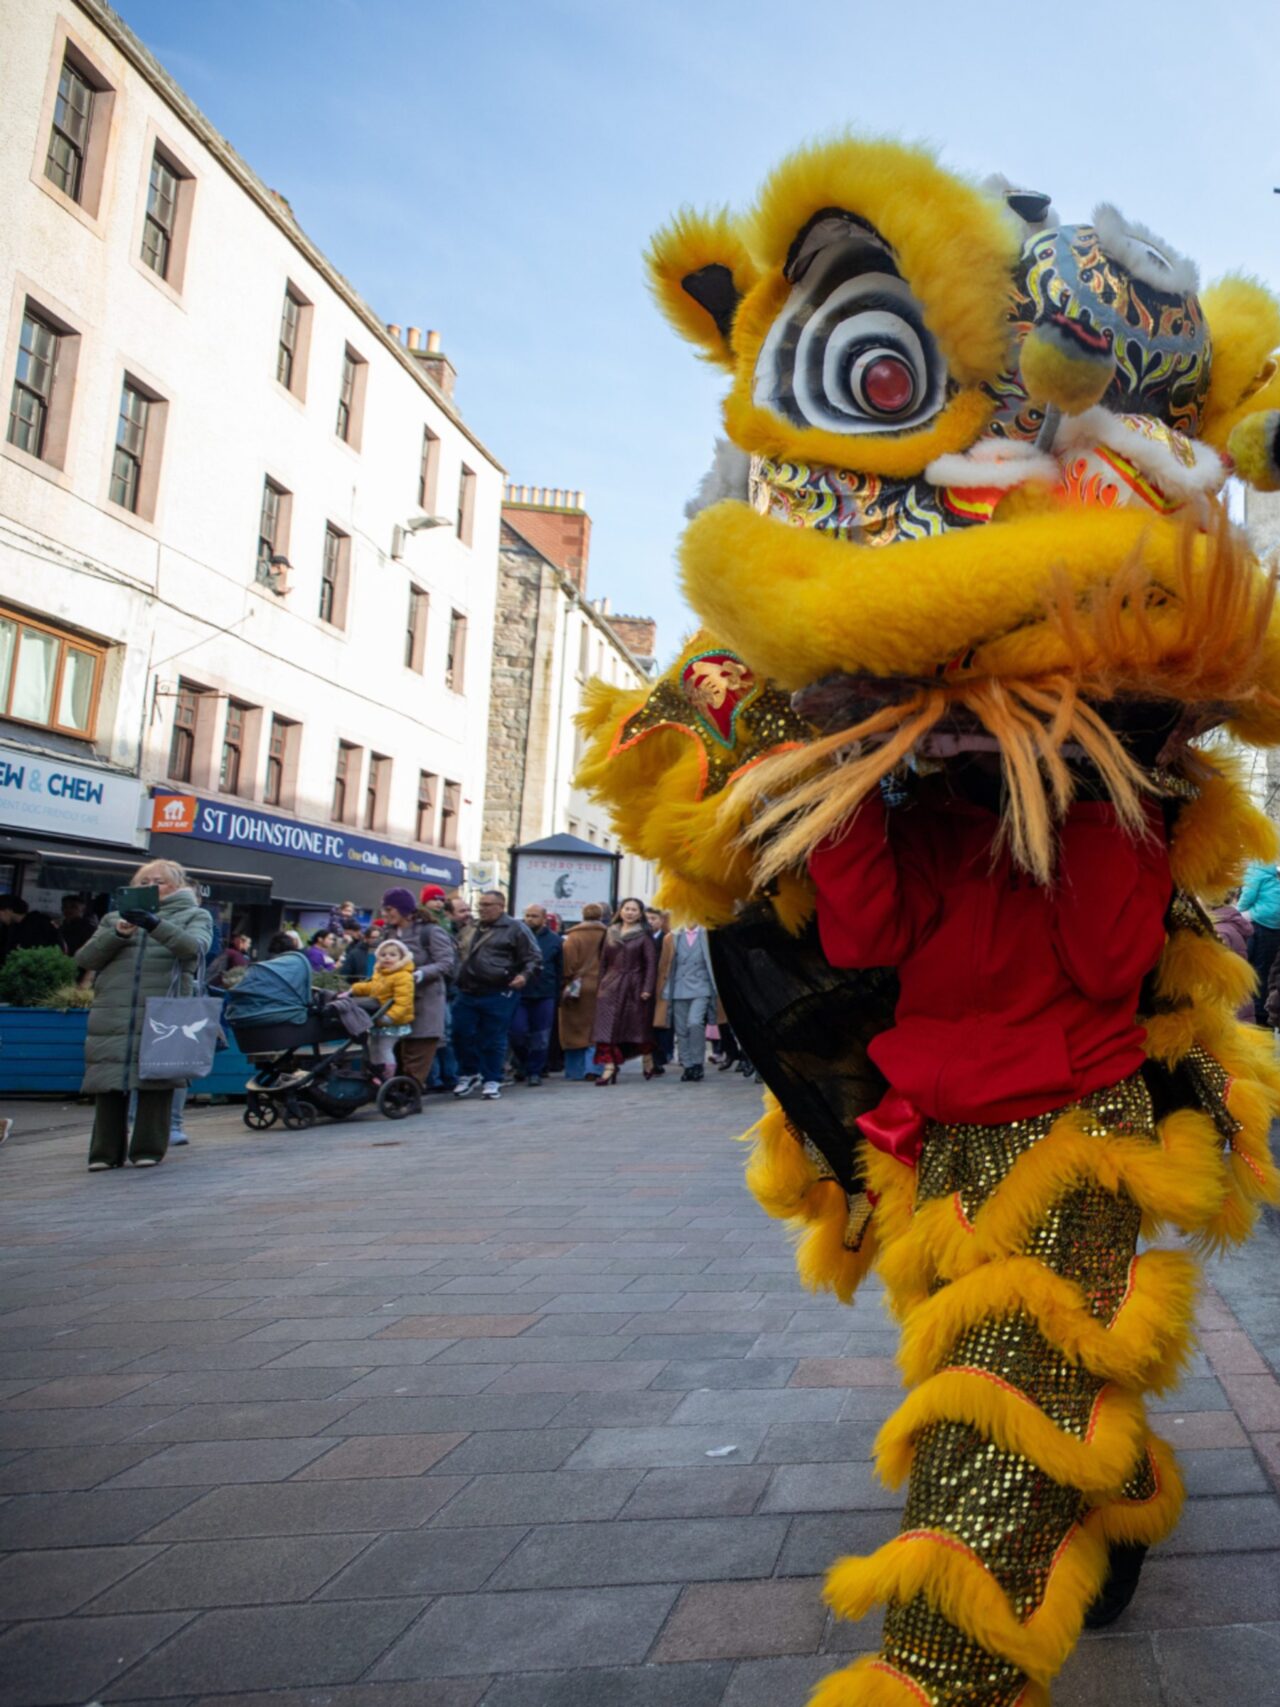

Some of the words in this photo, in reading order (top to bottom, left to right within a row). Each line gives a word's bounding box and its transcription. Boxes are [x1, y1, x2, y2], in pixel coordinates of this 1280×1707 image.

[28, 769, 42, 793] &
[48, 773, 104, 805] CHEW
[157, 821, 173, 829] JUST
[202, 808, 228, 834] ST
[228, 813, 323, 854] JOHNSTONE
[325, 834, 344, 858] FC
[527, 860, 573, 870] JETHRO
